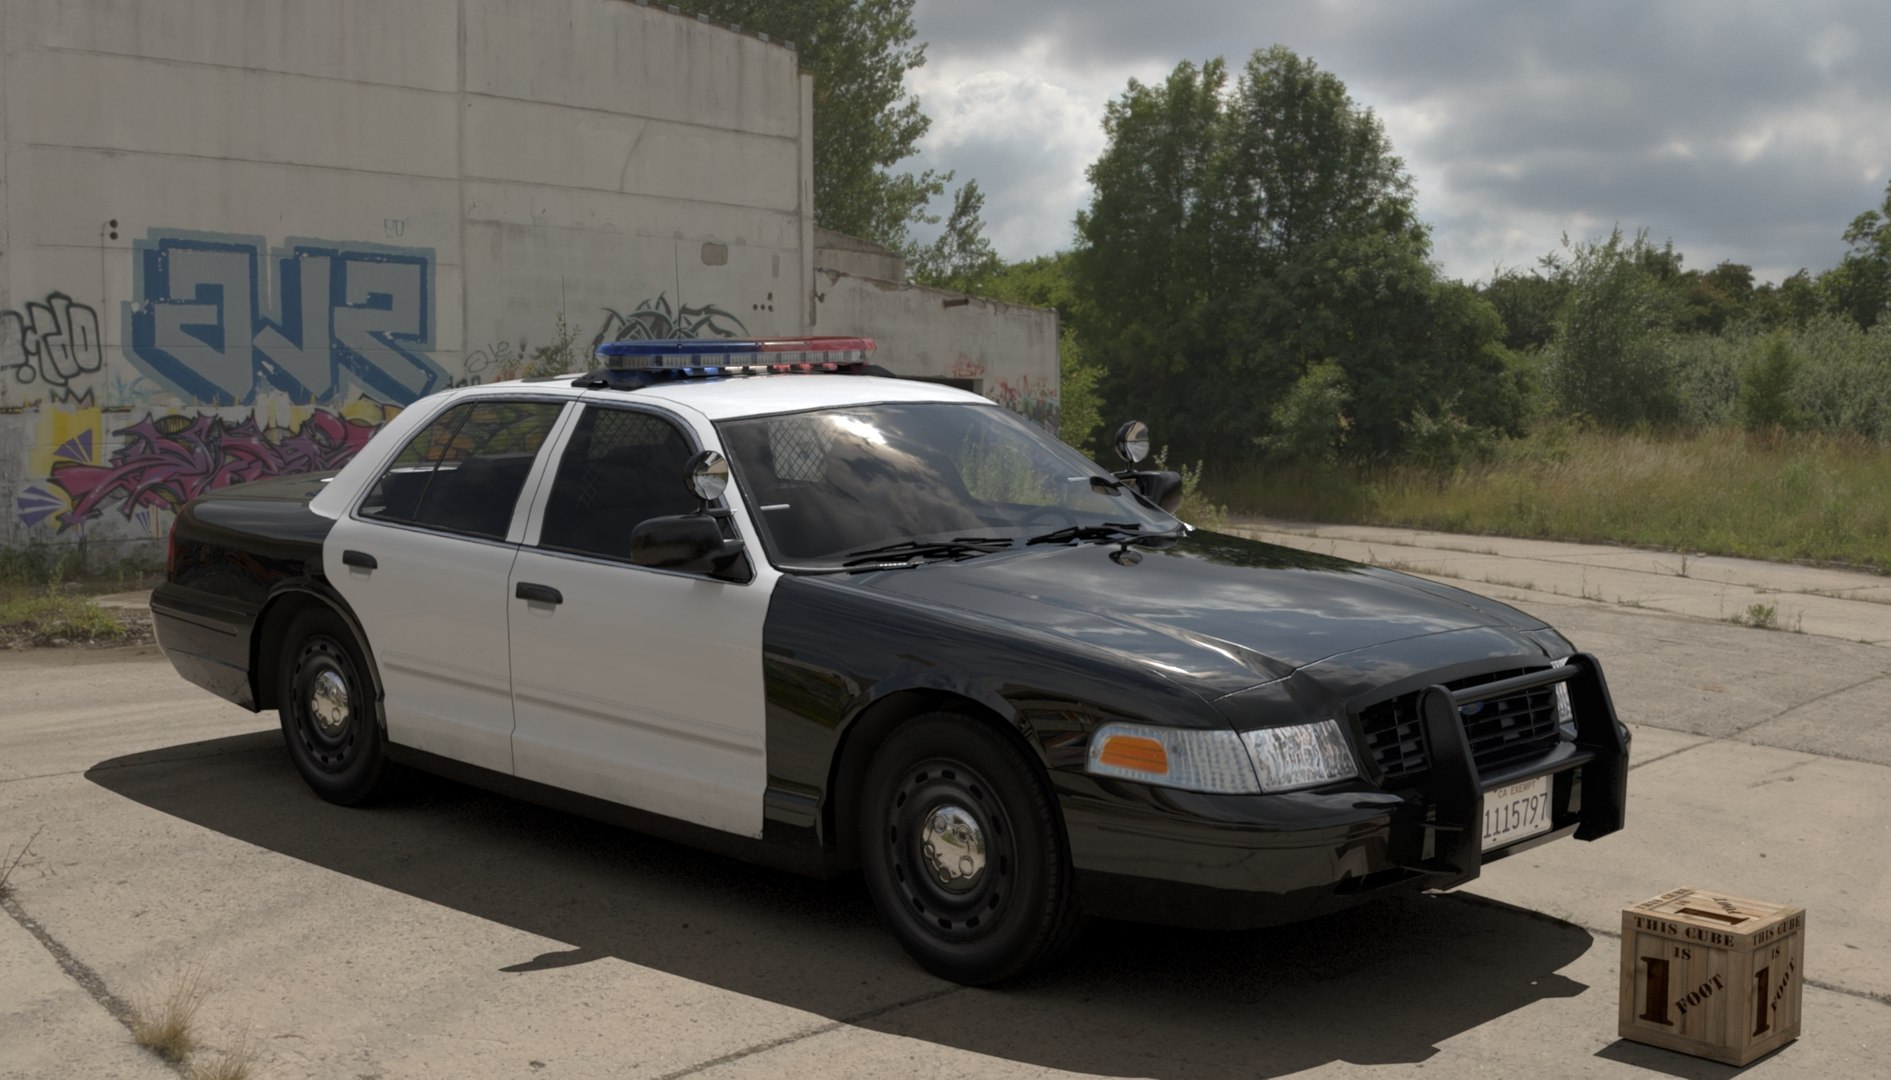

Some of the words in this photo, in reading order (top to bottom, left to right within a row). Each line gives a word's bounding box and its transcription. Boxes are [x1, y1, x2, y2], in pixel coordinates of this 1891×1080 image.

[1497, 789, 1507, 799] CA
[1510, 780, 1537, 795] EXEMPT
[1483, 792, 1548, 839] 1115797
[1634, 915, 1678, 936] THIS
[1685, 926, 1735, 948] CUBE
[1752, 929, 1775, 947] THIS
[1776, 915, 1801, 936] CUBE
[1673, 946, 1692, 961] IS
[1770, 946, 1781, 960] IS
[1638, 955, 1675, 1027] 1
[1674, 973, 1725, 1016] FOOT
[1752, 966, 1771, 1038] 1
[1769, 957, 1796, 1013] FOOT
